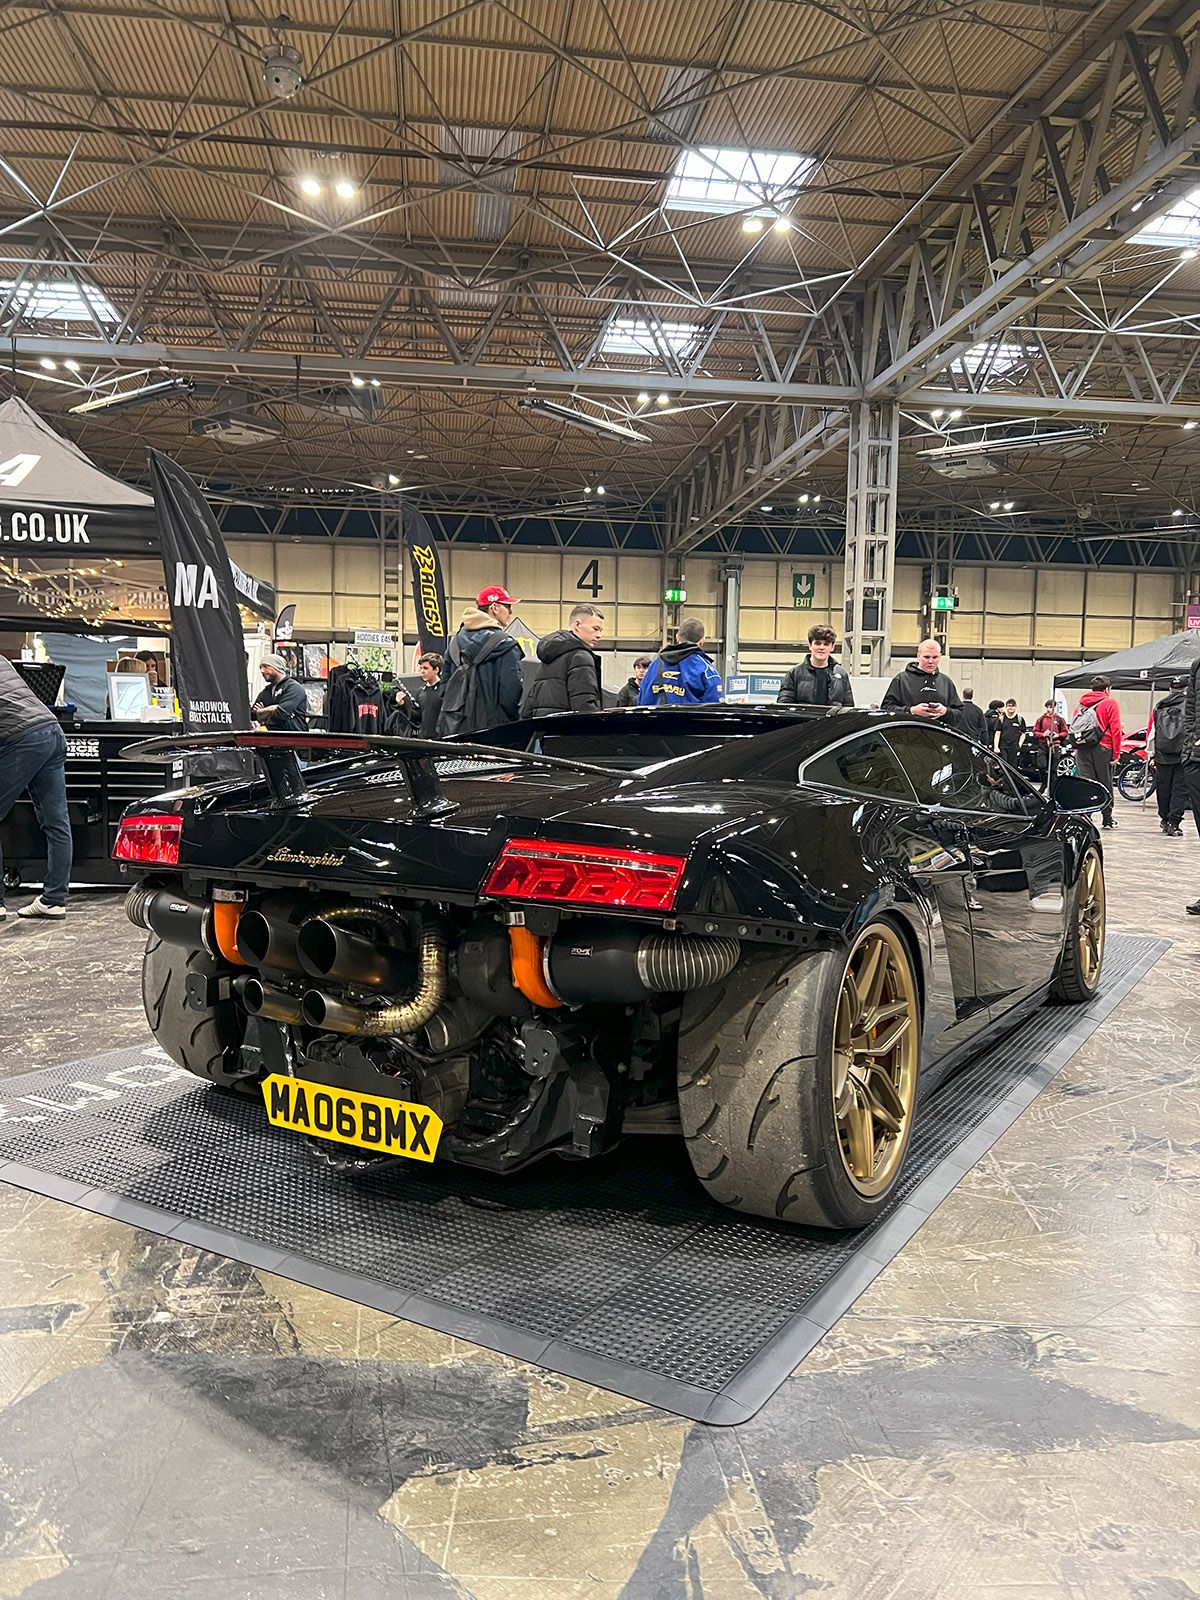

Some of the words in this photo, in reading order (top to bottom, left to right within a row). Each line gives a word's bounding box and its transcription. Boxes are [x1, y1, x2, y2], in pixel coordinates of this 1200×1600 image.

[174, 561, 219, 608] MA
[413, 544, 444, 636] BAGGSY
[576, 559, 603, 598] 4
[795, 597, 811, 607] EXIT
[356, 633, 379, 642] HOODIES
[267, 846, 346, 868] Lamborghini
[270, 1082, 431, 1155] MA06BMX
